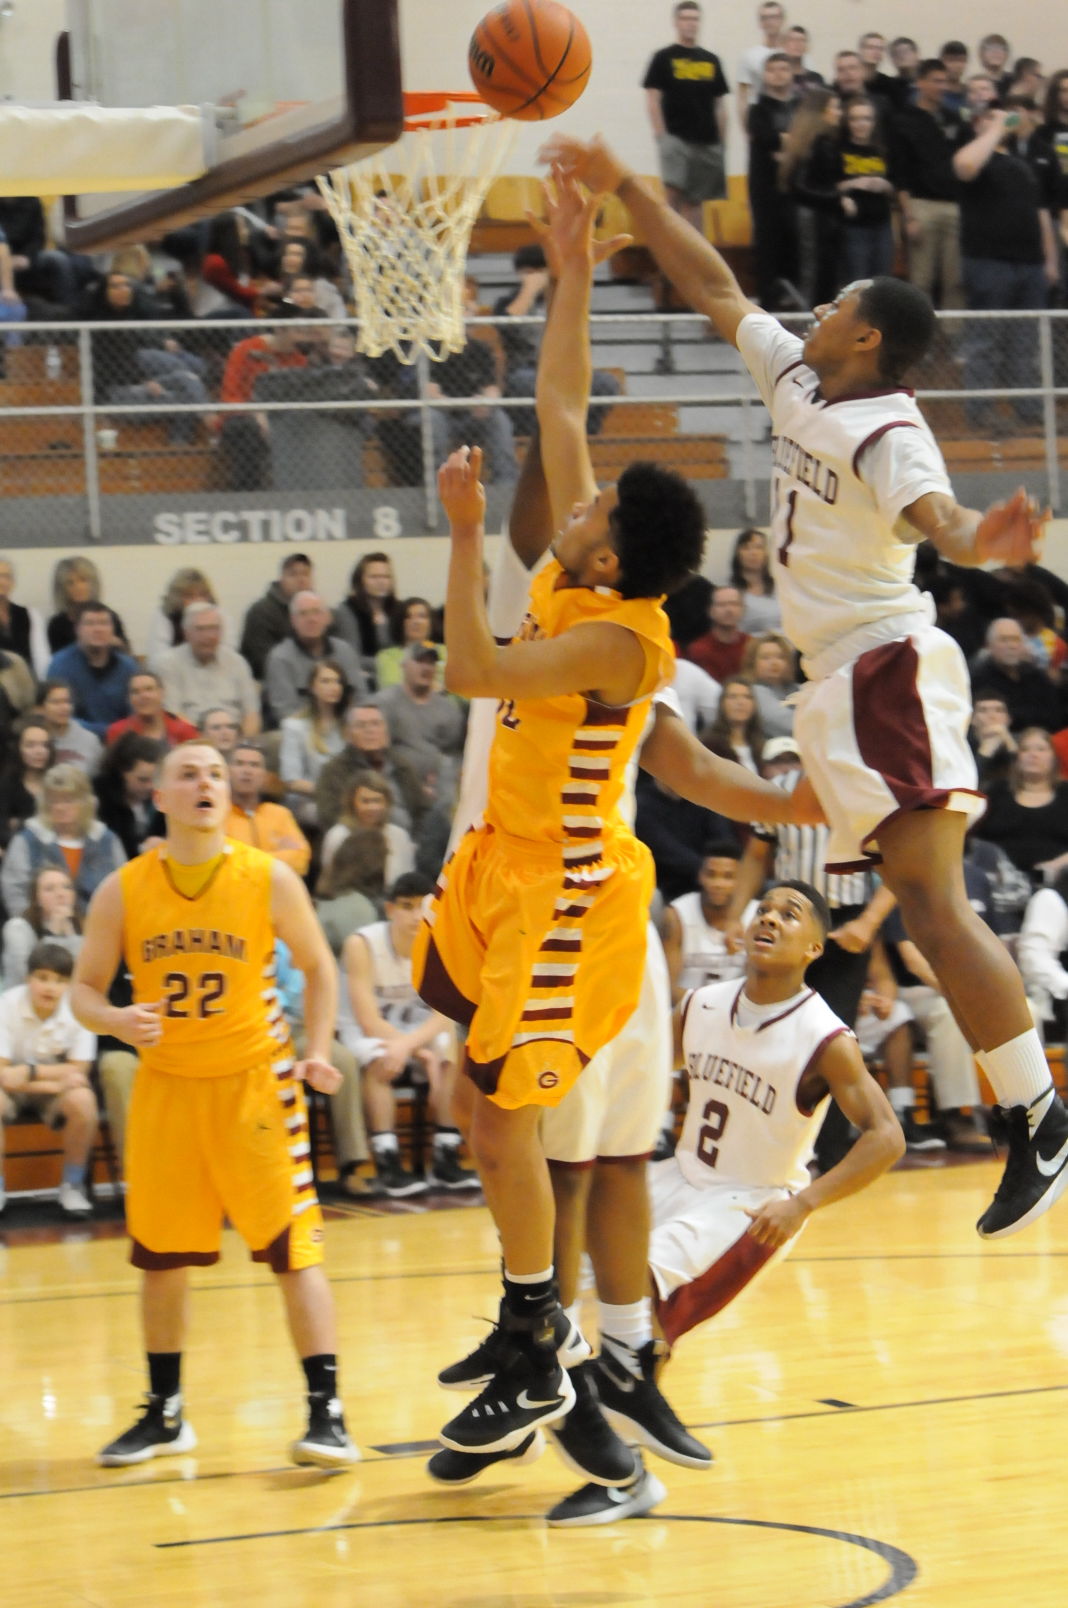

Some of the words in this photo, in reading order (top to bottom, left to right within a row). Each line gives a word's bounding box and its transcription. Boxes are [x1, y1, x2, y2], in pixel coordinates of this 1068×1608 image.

[153, 508, 348, 545] SECTION
[372, 506, 402, 539] 8
[142, 929, 249, 964] GRAHAM
[163, 972, 225, 1019] 22
[538, 1071, 559, 1089] G
[697, 1098, 730, 1169] 2
